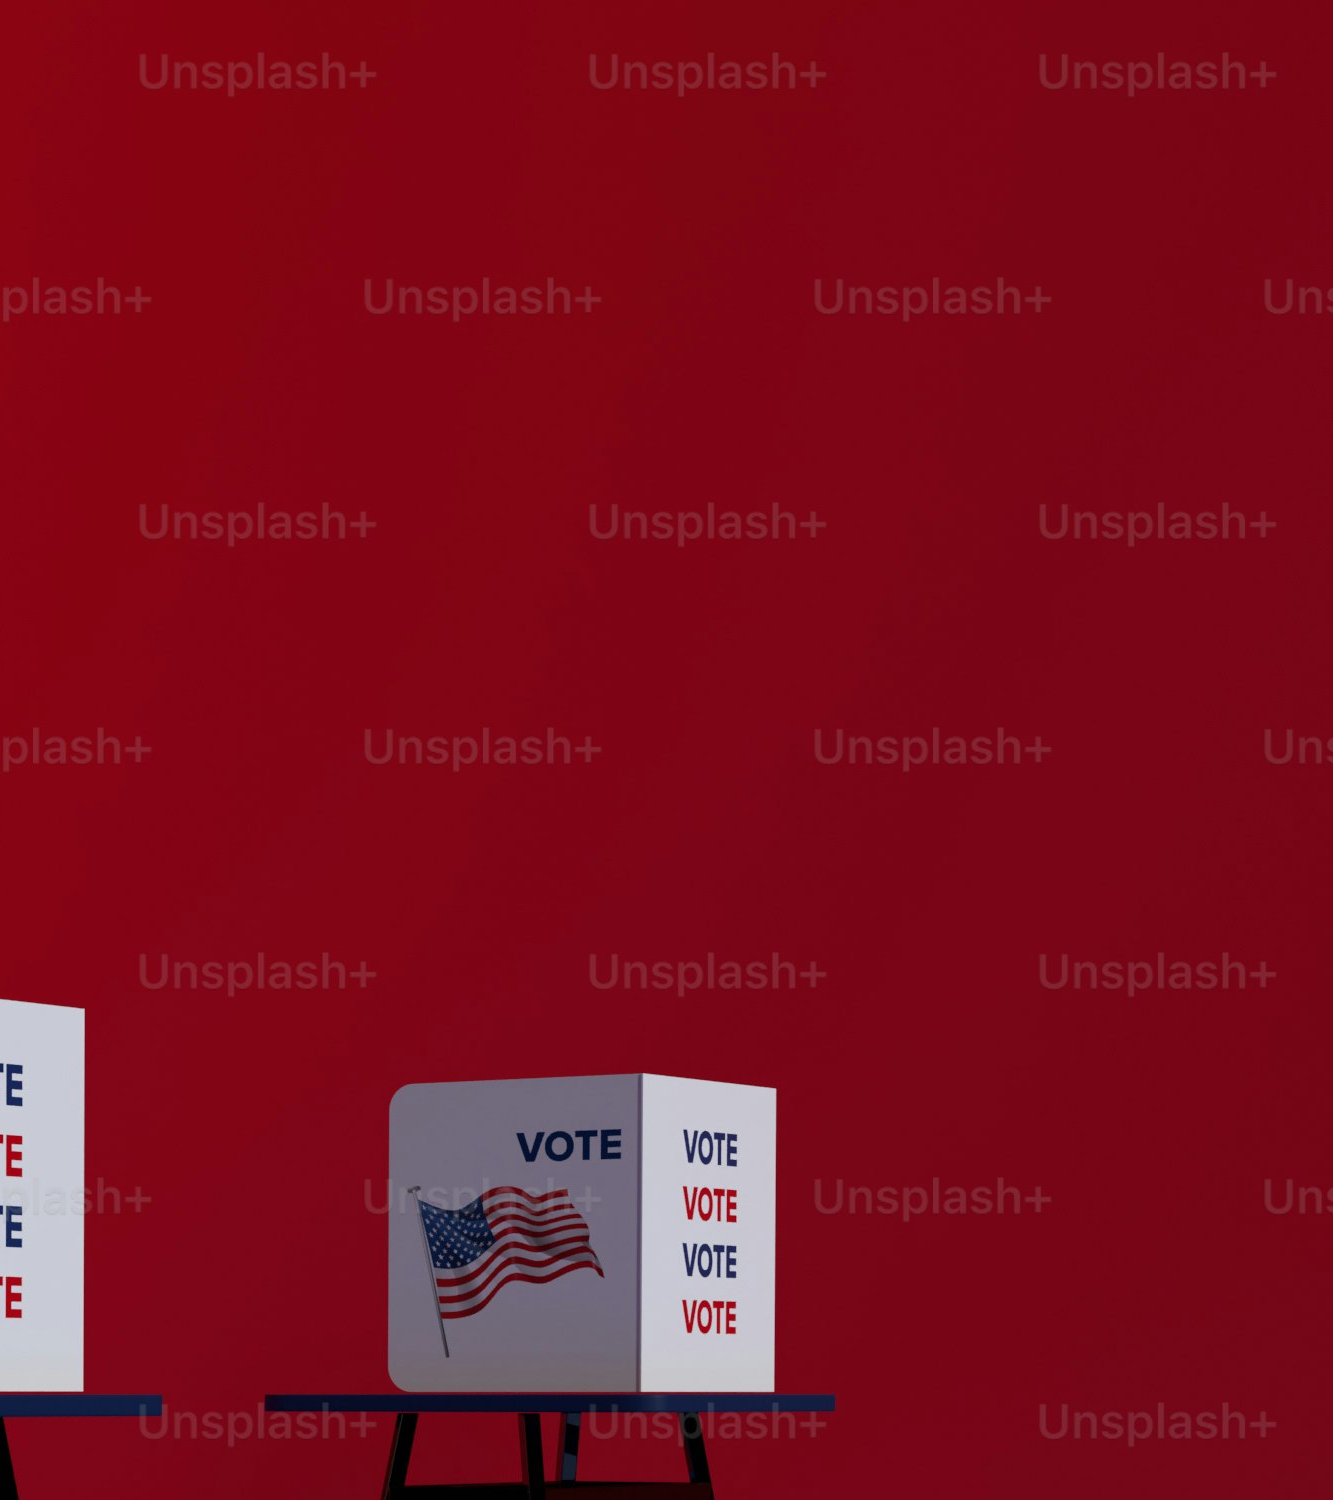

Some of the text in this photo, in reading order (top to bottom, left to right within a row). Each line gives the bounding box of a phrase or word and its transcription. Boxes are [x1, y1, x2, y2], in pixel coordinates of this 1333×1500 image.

[517, 1129, 621, 1162] VOTE
[684, 1130, 737, 1166] VOTE
[683, 1186, 737, 1222] VOTE
[683, 1243, 736, 1278] VOTE
[682, 1300, 736, 1334] VOTE
